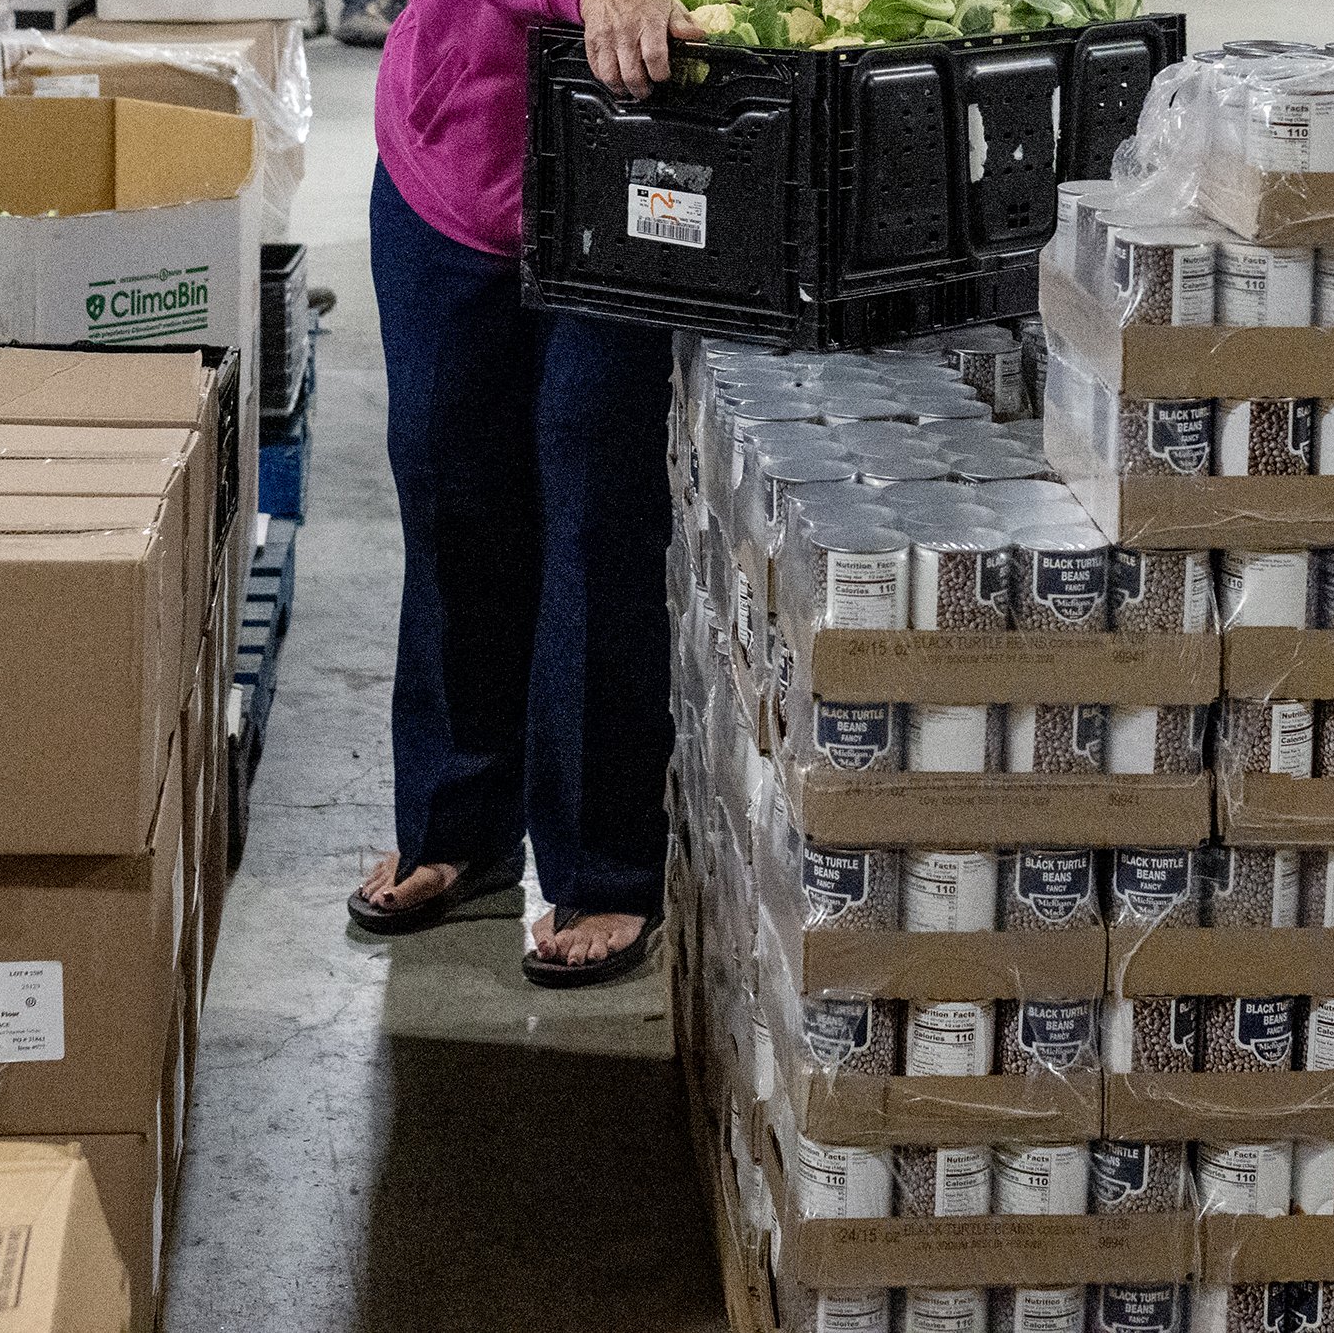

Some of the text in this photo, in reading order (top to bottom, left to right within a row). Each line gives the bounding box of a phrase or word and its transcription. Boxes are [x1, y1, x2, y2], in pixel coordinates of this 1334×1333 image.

[110, 281, 207, 318] ClimaBin
[1061, 570, 1089, 581] BEANS
[850, 708, 884, 719] TURTLE
[837, 722, 868, 733] BEANS
[1025, 857, 1087, 870] BLACK TURTLE
[1149, 858, 1183, 869] TURTLE
[1042, 872, 1072, 883] BEANS
[1136, 869, 1166, 881] BEANS
[936, 885, 956, 894] 110
[1046, 1018, 1074, 1031] BEANS
[826, 1176, 846, 1185] 110
